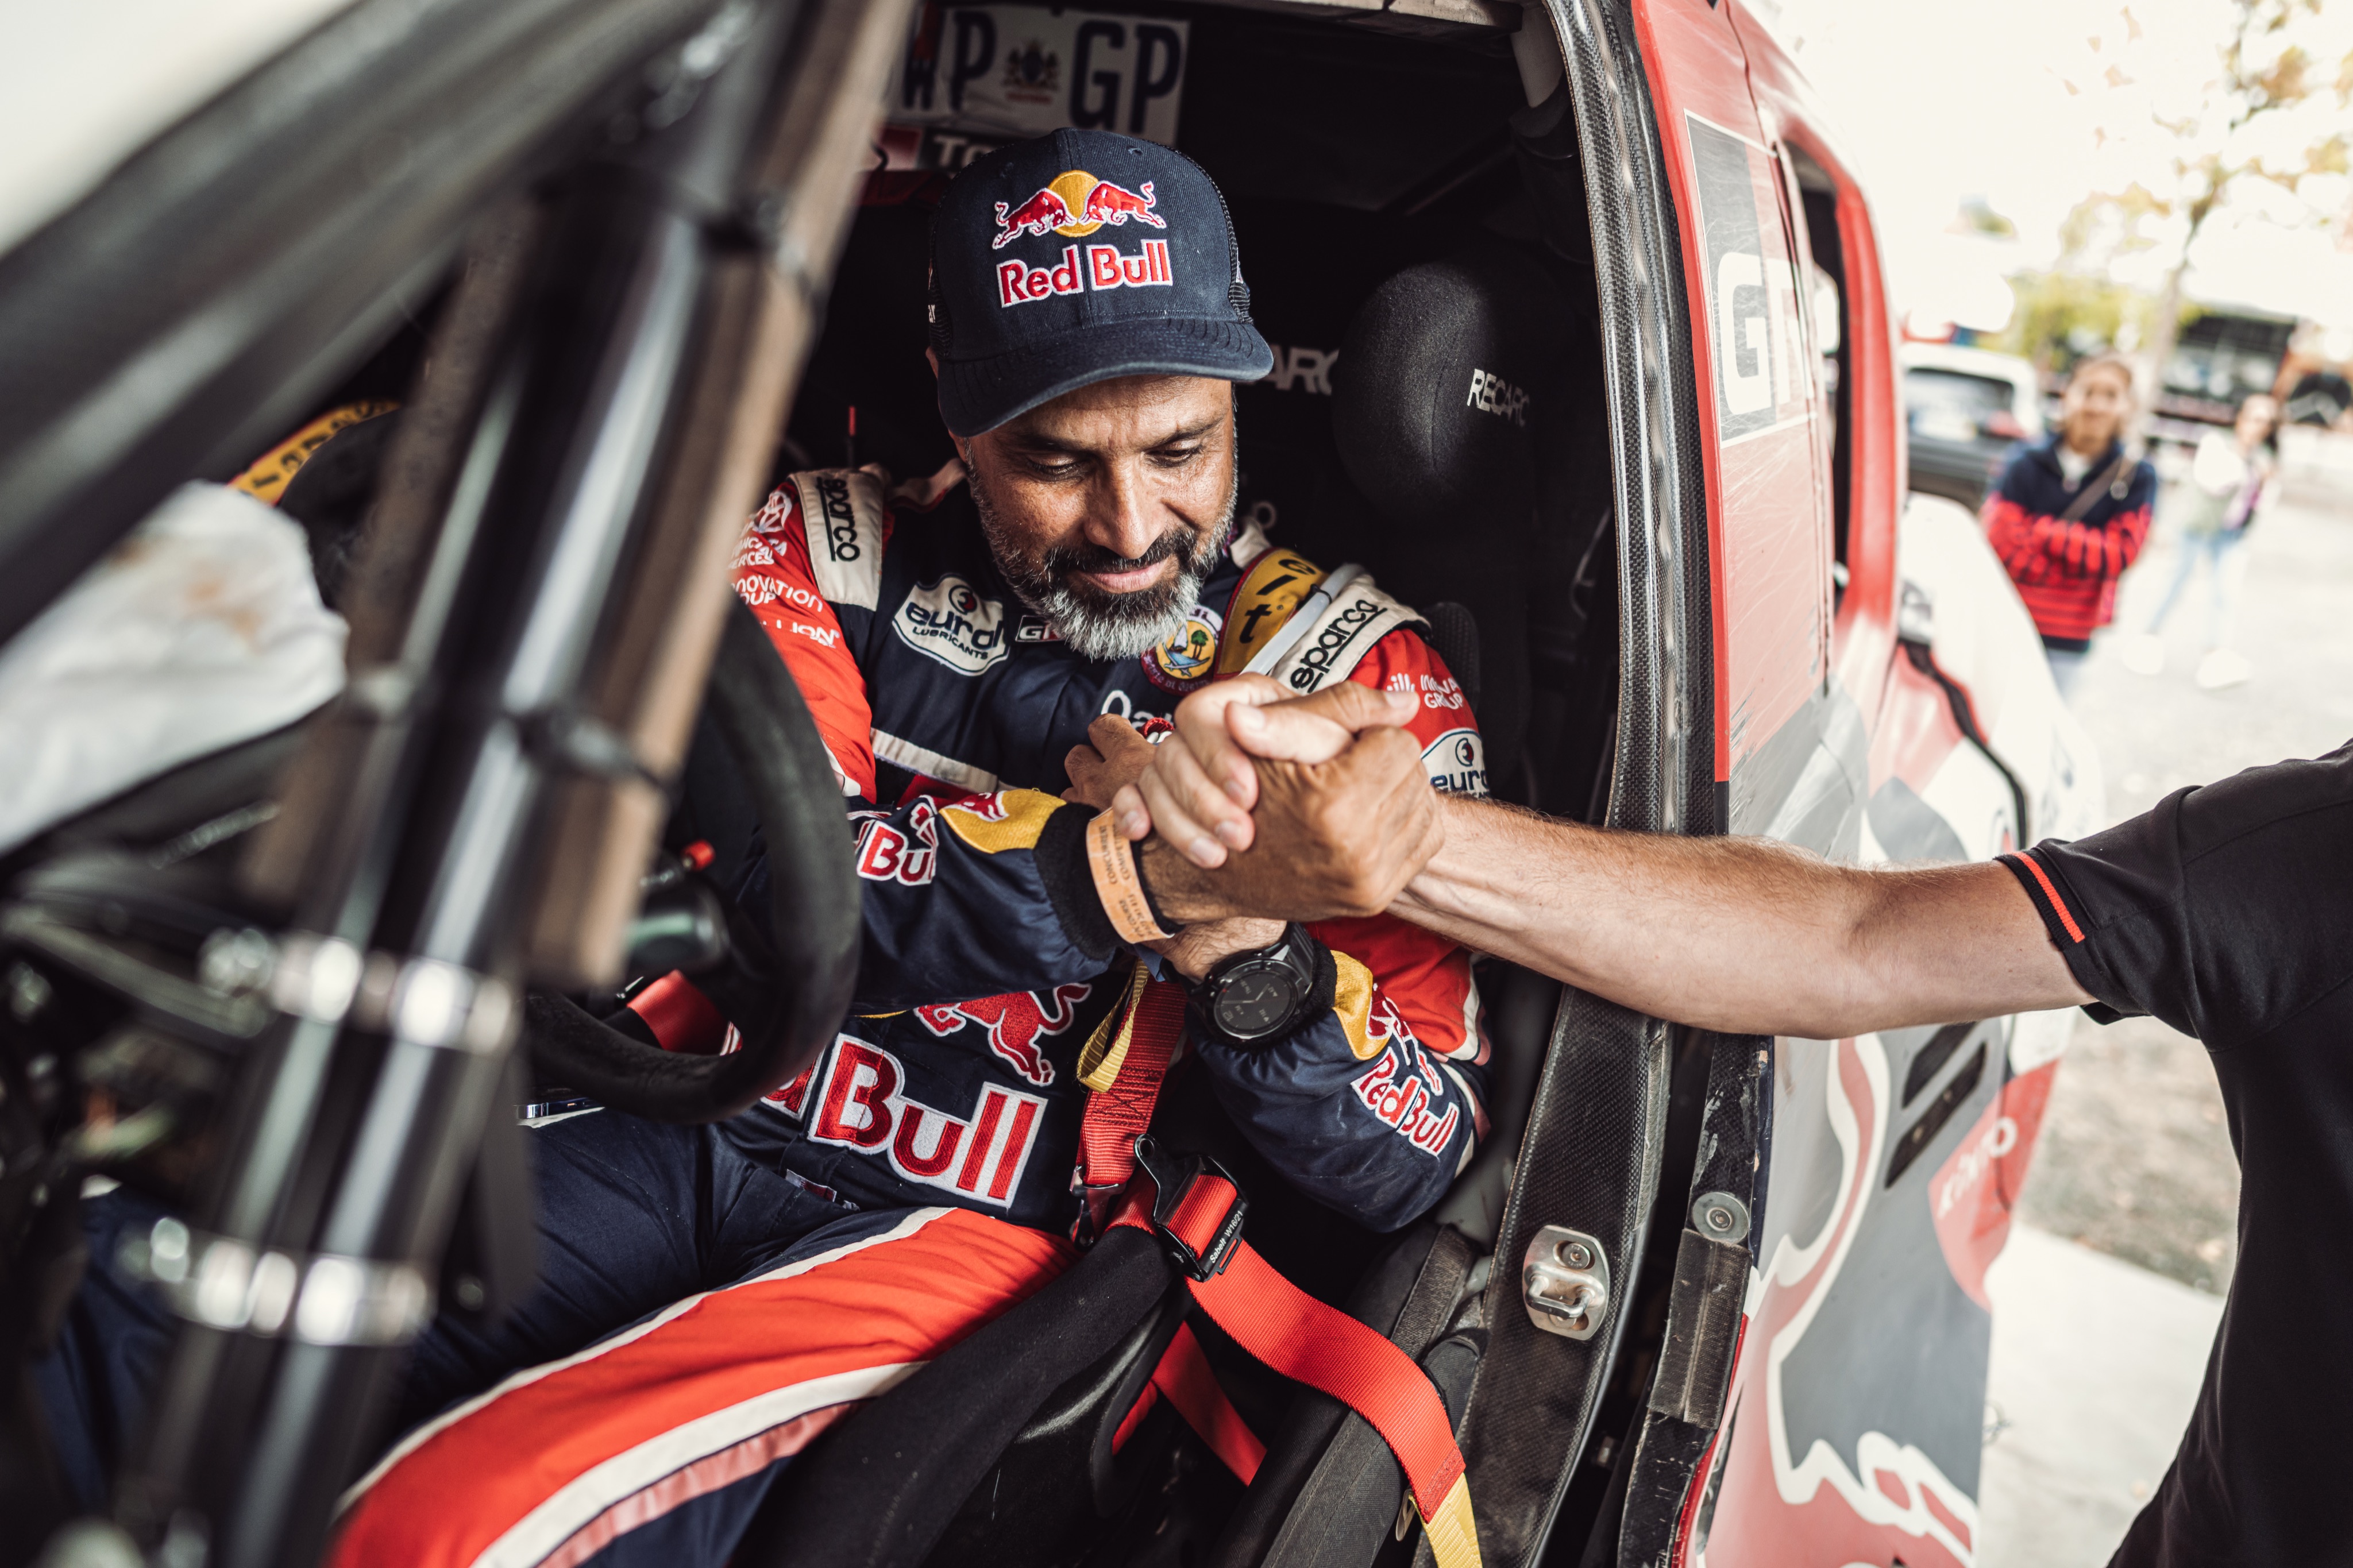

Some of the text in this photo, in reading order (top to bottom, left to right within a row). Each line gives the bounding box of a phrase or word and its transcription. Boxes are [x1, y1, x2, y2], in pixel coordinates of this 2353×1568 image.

[1069, 20, 1181, 133] GP
[997, 240, 1172, 307] Red Bull
[820, 478, 860, 562] sparco
[913, 627, 989, 659] LUBRICANTS
[1290, 600, 1388, 694] sparco
[808, 1033, 1048, 1206] Bull
[1351, 1047, 1460, 1156] Red Bull
[1210, 1210, 1243, 1263] Sabelt W16/21
